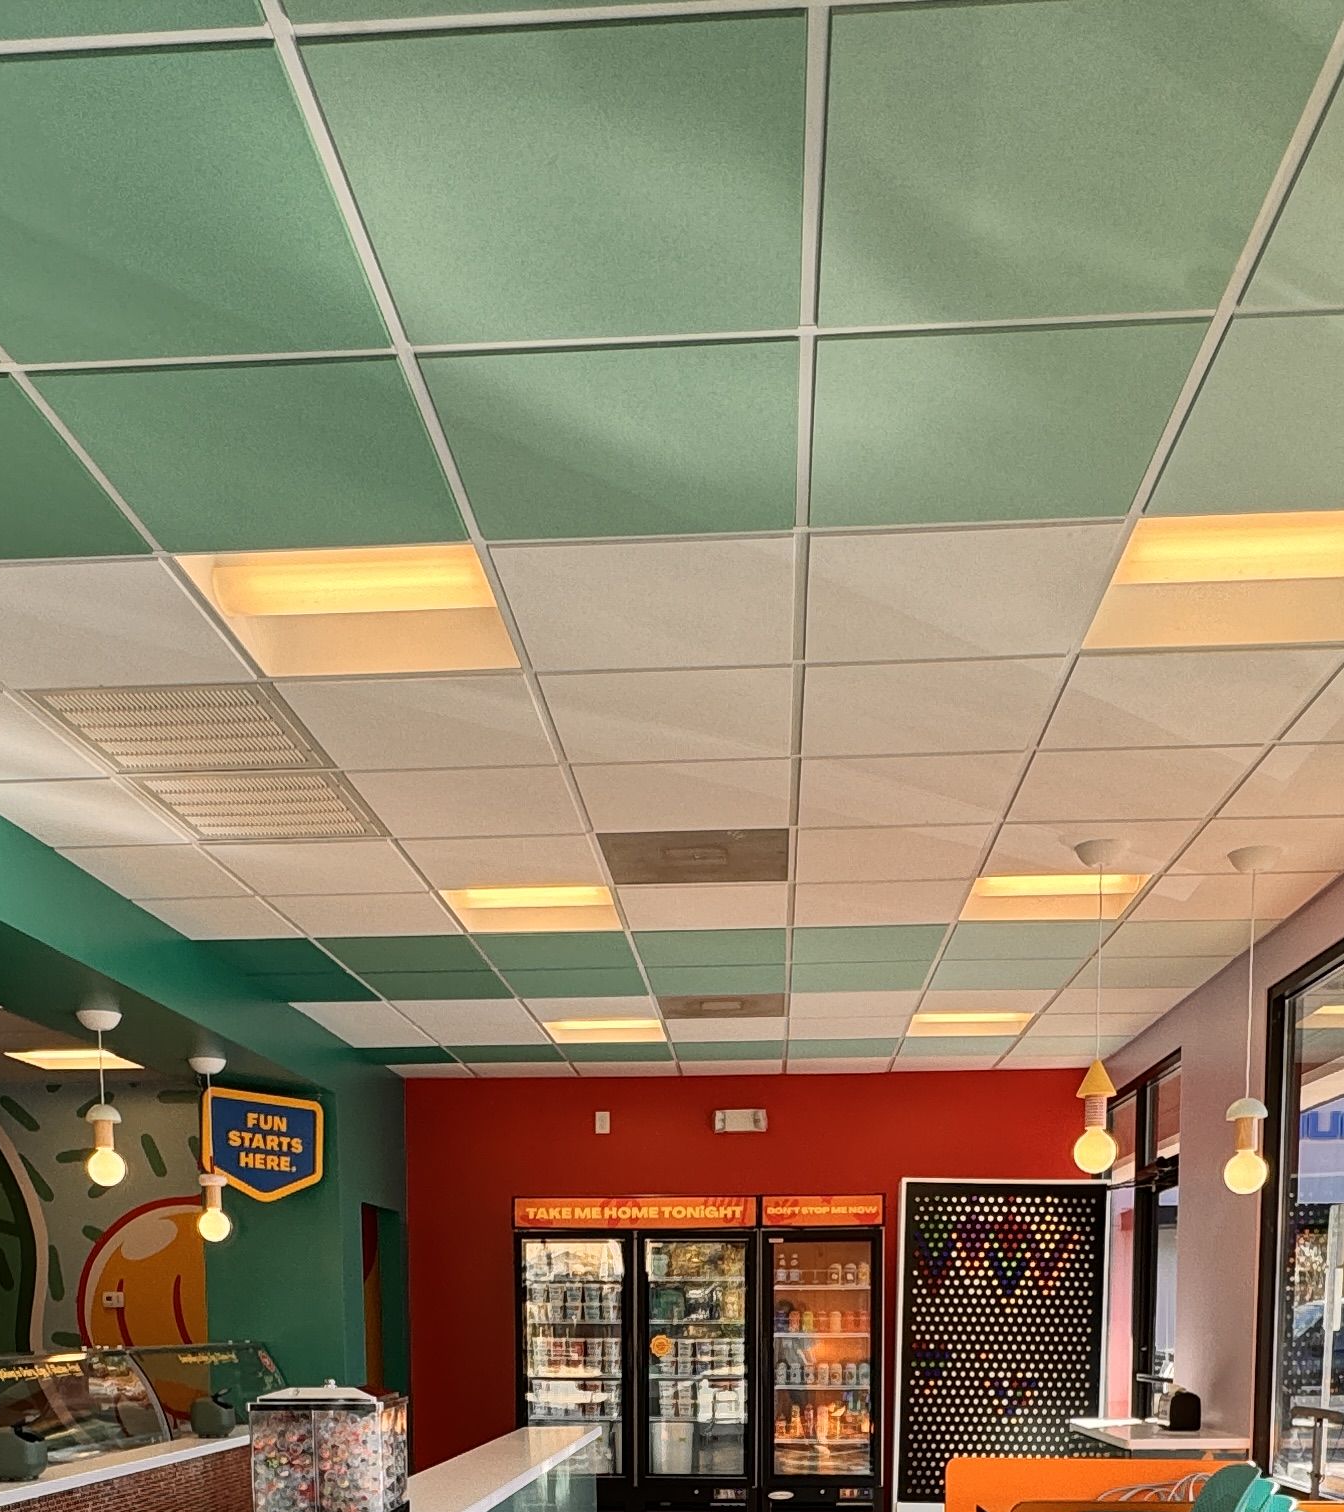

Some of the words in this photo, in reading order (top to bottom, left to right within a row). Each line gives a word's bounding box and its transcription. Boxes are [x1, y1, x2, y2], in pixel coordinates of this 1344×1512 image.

[246, 1112, 287, 1132] FUN
[227, 1130, 303, 1154] STARTS
[239, 1151, 296, 1172] HERE.
[526, 1207, 572, 1220] TAKE
[574, 1207, 601, 1219] ME
[605, 1206, 659, 1219] HOME
[801, 1206, 830, 1214] STOP
[831, 1206, 847, 1214] ME
[848, 1206, 878, 1214] NOW
